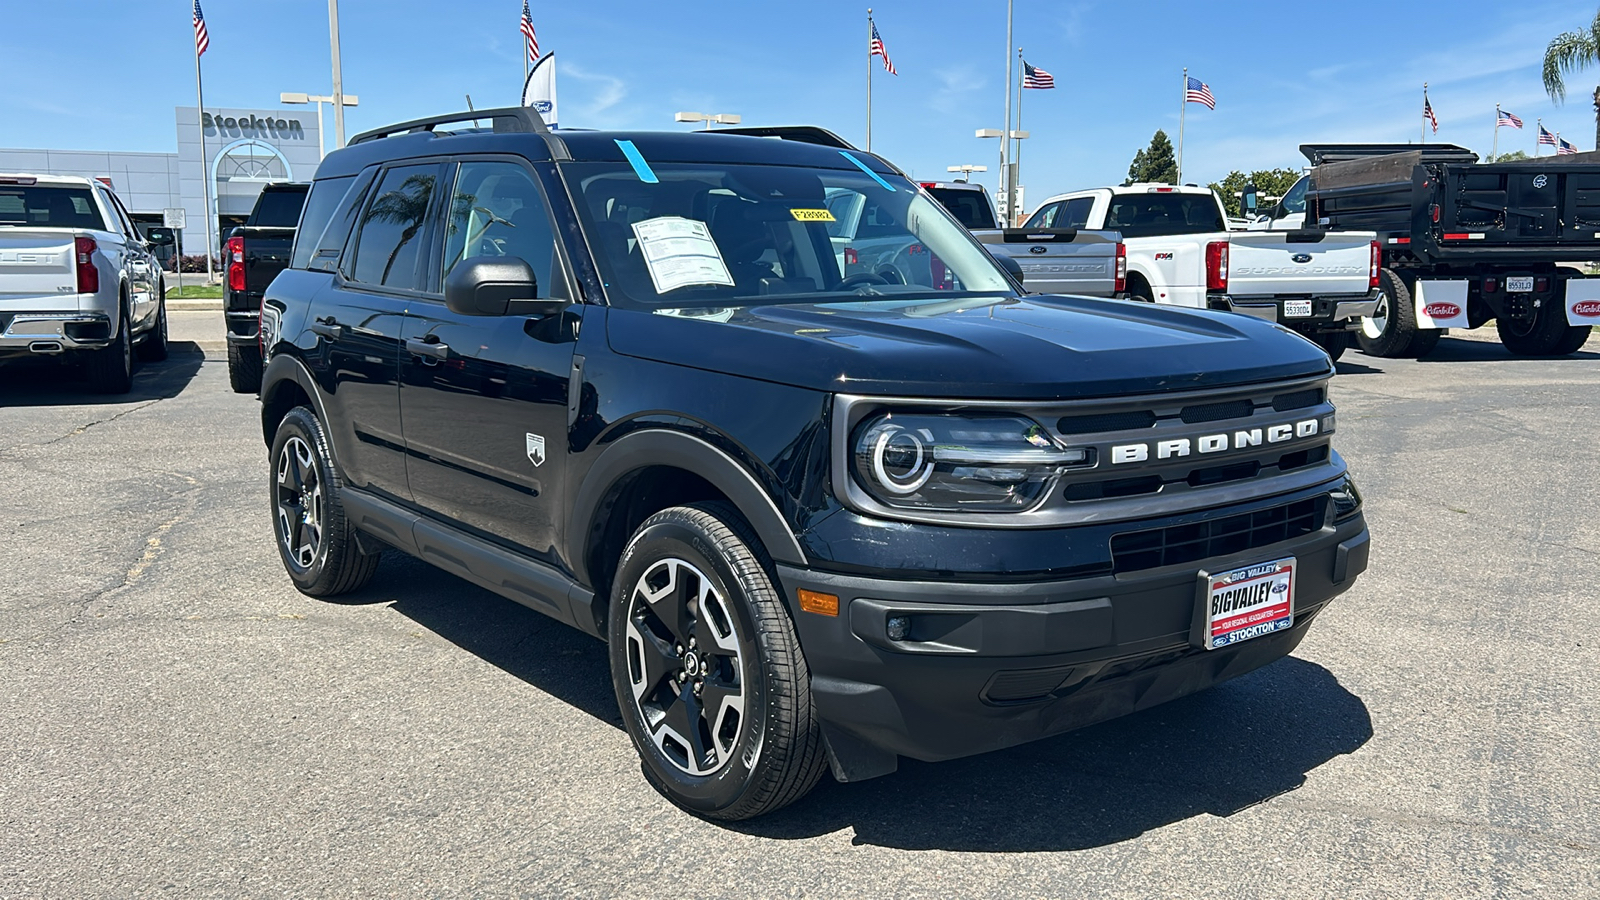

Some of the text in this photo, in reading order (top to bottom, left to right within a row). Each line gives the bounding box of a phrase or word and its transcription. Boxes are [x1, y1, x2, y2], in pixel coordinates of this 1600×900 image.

[532, 101, 551, 112] Ford
[202, 112, 301, 131] Stockton
[1154, 252, 1173, 260] FX4
[1293, 254, 1311, 262] Ford
[1237, 266, 1363, 275] SUPER DUTY
[1426, 304, 1457, 315] Peterbilt
[1112, 419, 1318, 464] BRONCO
[1231, 564, 1276, 581] BIG VALLEY
[1273, 584, 1287, 593] Ford
[1212, 581, 1273, 616] BIGVALLEY
[1222, 621, 1232, 629] YOUR
[1229, 621, 1275, 642] STOCKTON
